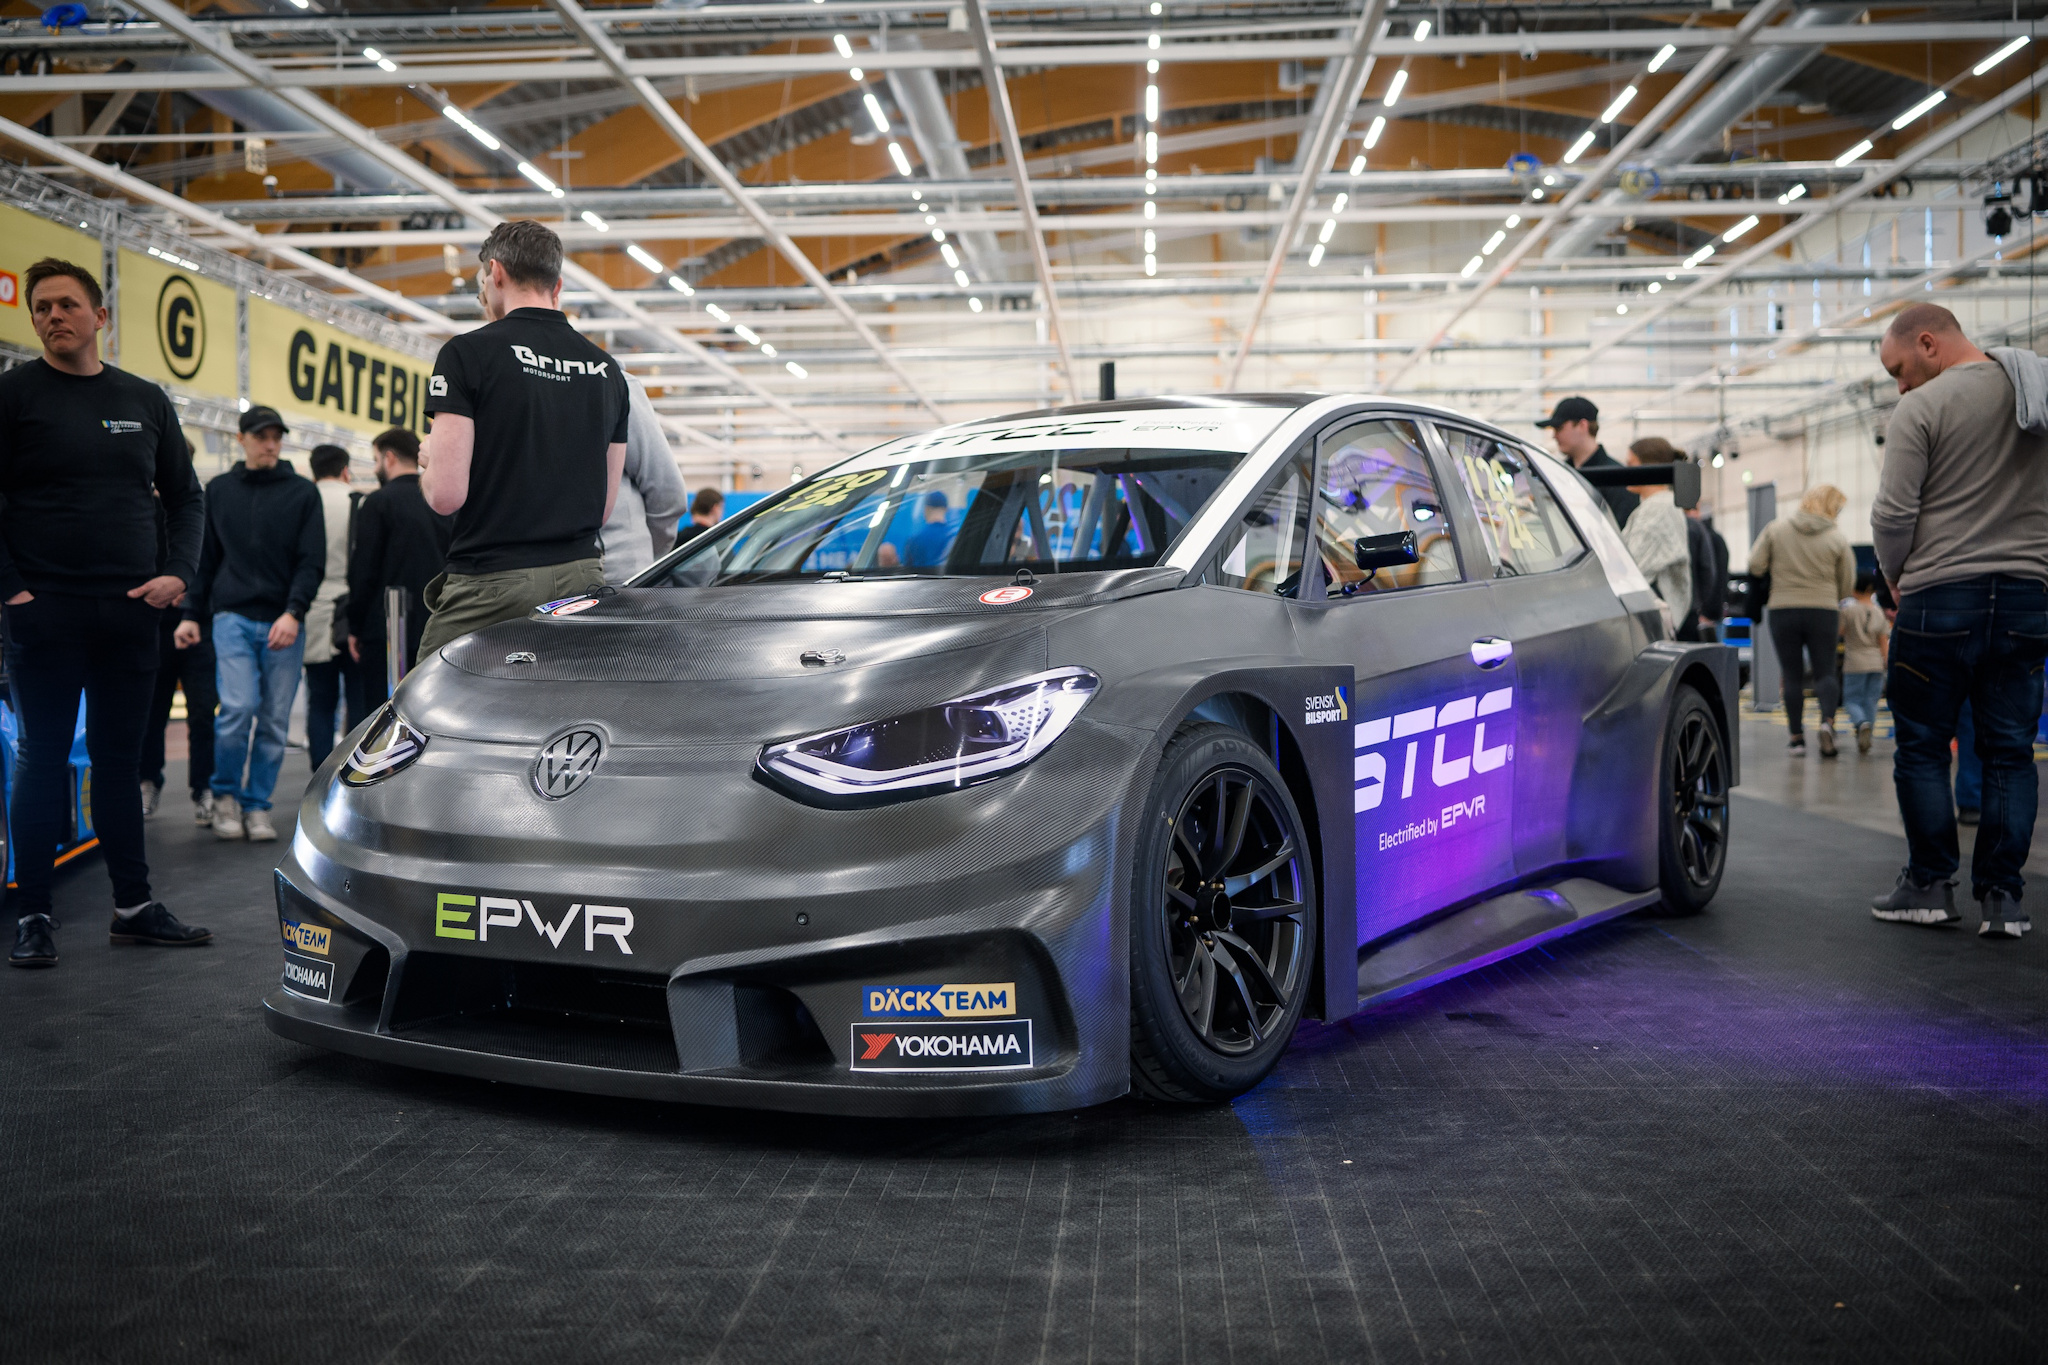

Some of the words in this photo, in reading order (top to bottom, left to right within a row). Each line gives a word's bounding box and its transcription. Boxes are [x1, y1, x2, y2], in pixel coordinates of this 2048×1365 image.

[522, 366, 571, 382] MOTORSPORT
[994, 589, 1020, 599] E
[1305, 695, 1335, 711] SVENSK
[1305, 708, 1342, 725] BILSPORT
[1355, 686, 1513, 814] STCC
[1379, 818, 1426, 852] Electrified
[1427, 817, 1439, 837] by
[435, 892, 634, 955] EPWR
[298, 928, 328, 949] TEAM
[894, 1033, 1022, 1057] YOKOHAMA
